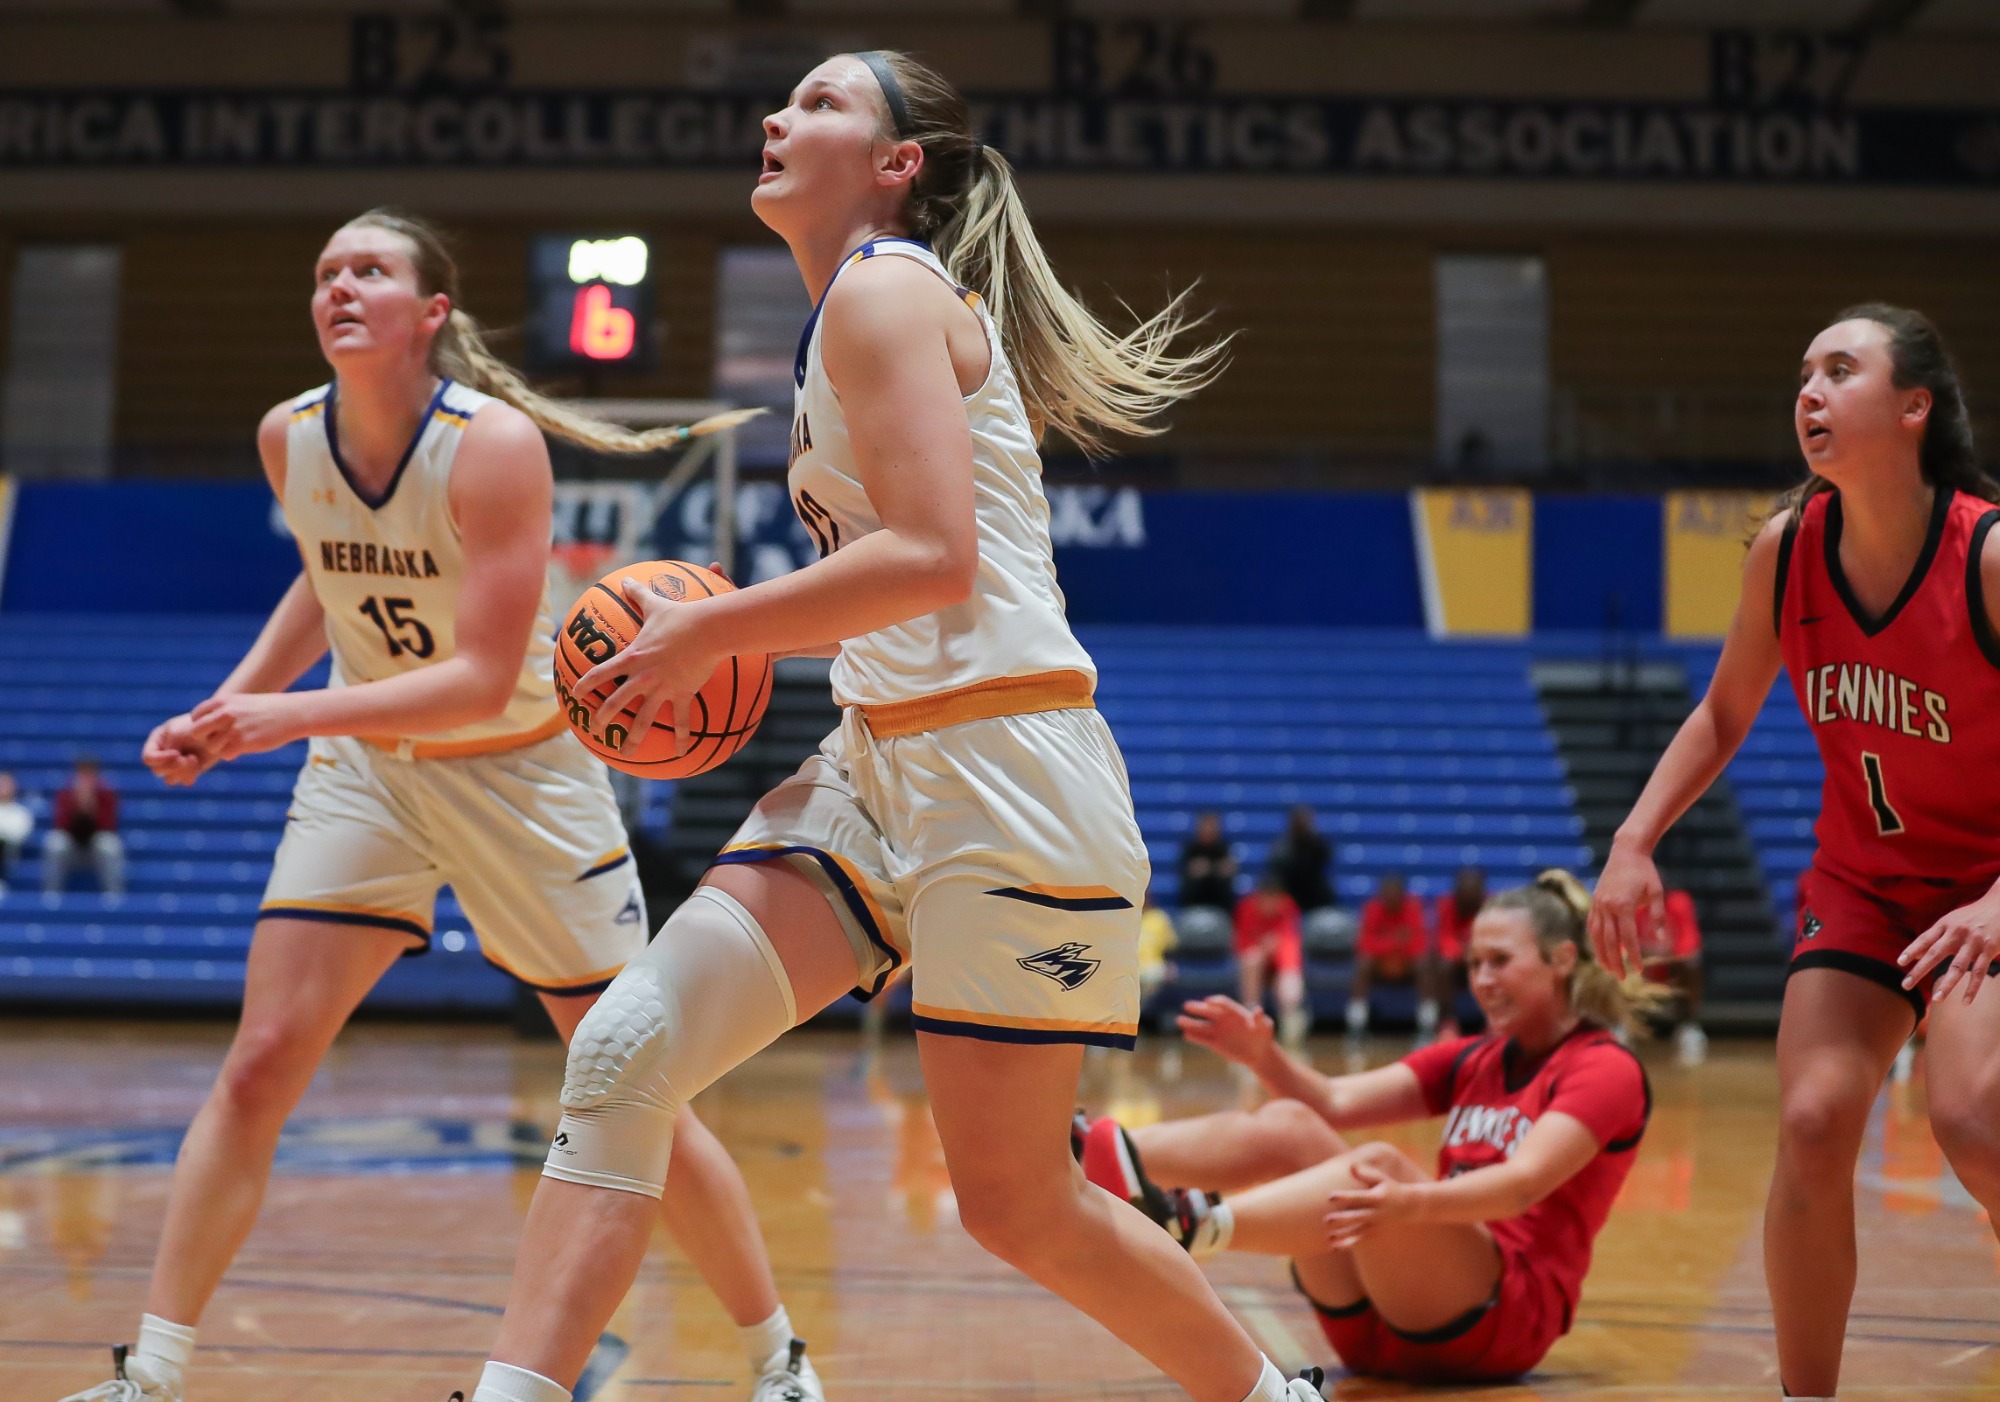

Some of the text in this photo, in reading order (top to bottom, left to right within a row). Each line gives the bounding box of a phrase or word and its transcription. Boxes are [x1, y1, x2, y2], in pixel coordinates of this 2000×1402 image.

[1353, 107, 1861, 176] ASSOCIATION
[321, 540, 440, 579] NEBRASKA
[358, 596, 435, 658] 15
[1861, 750, 1905, 836] 1
